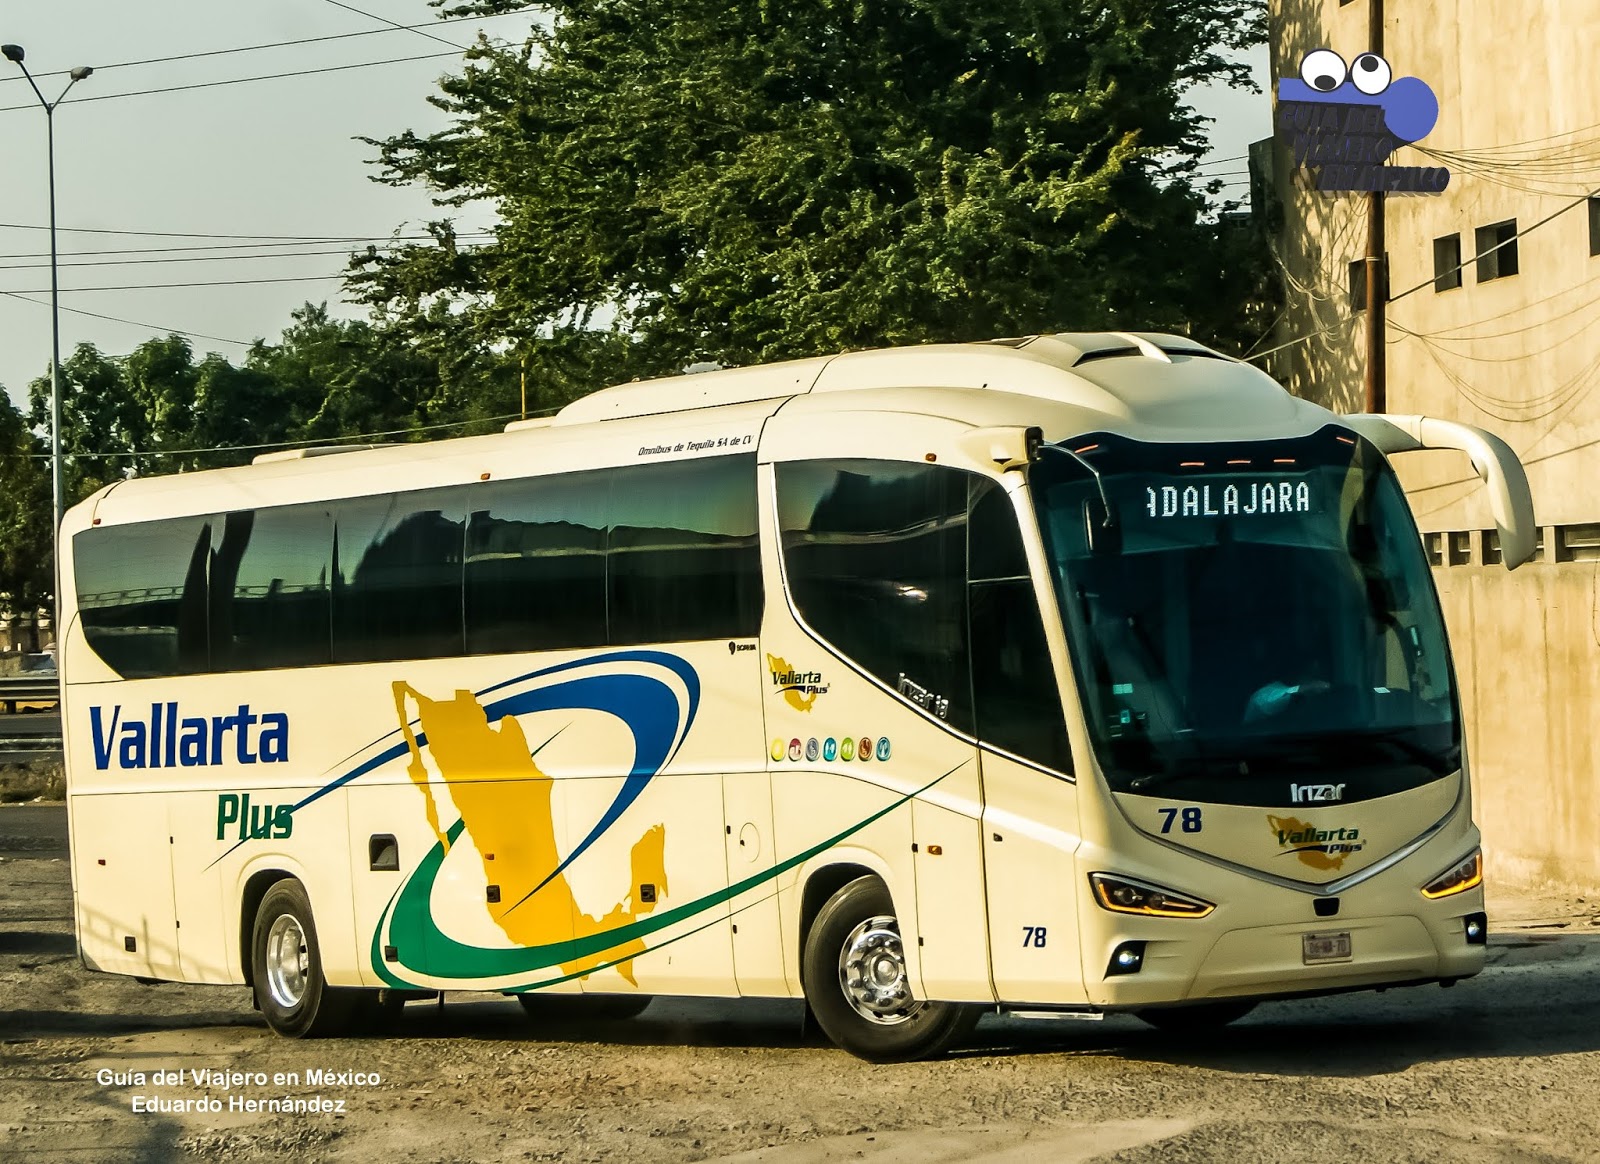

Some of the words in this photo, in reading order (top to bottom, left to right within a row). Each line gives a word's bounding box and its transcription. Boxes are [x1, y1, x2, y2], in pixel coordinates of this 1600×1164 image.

[638, 445, 672, 456] Omnibus
[673, 443, 685, 452] de
[687, 439, 715, 452] Tequila
[730, 436, 741, 446] de
[773, 671, 822, 685] Vallarta
[806, 685, 828, 694] Plus
[89, 701, 289, 770] Vallarta
[1290, 783, 1346, 802] Irizar
[216, 793, 294, 841] Plus
[1158, 807, 1203, 834] 78
[1278, 827, 1359, 846] Vallarta
[1328, 843, 1362, 855] Plus
[1022, 926, 1047, 948] 78
